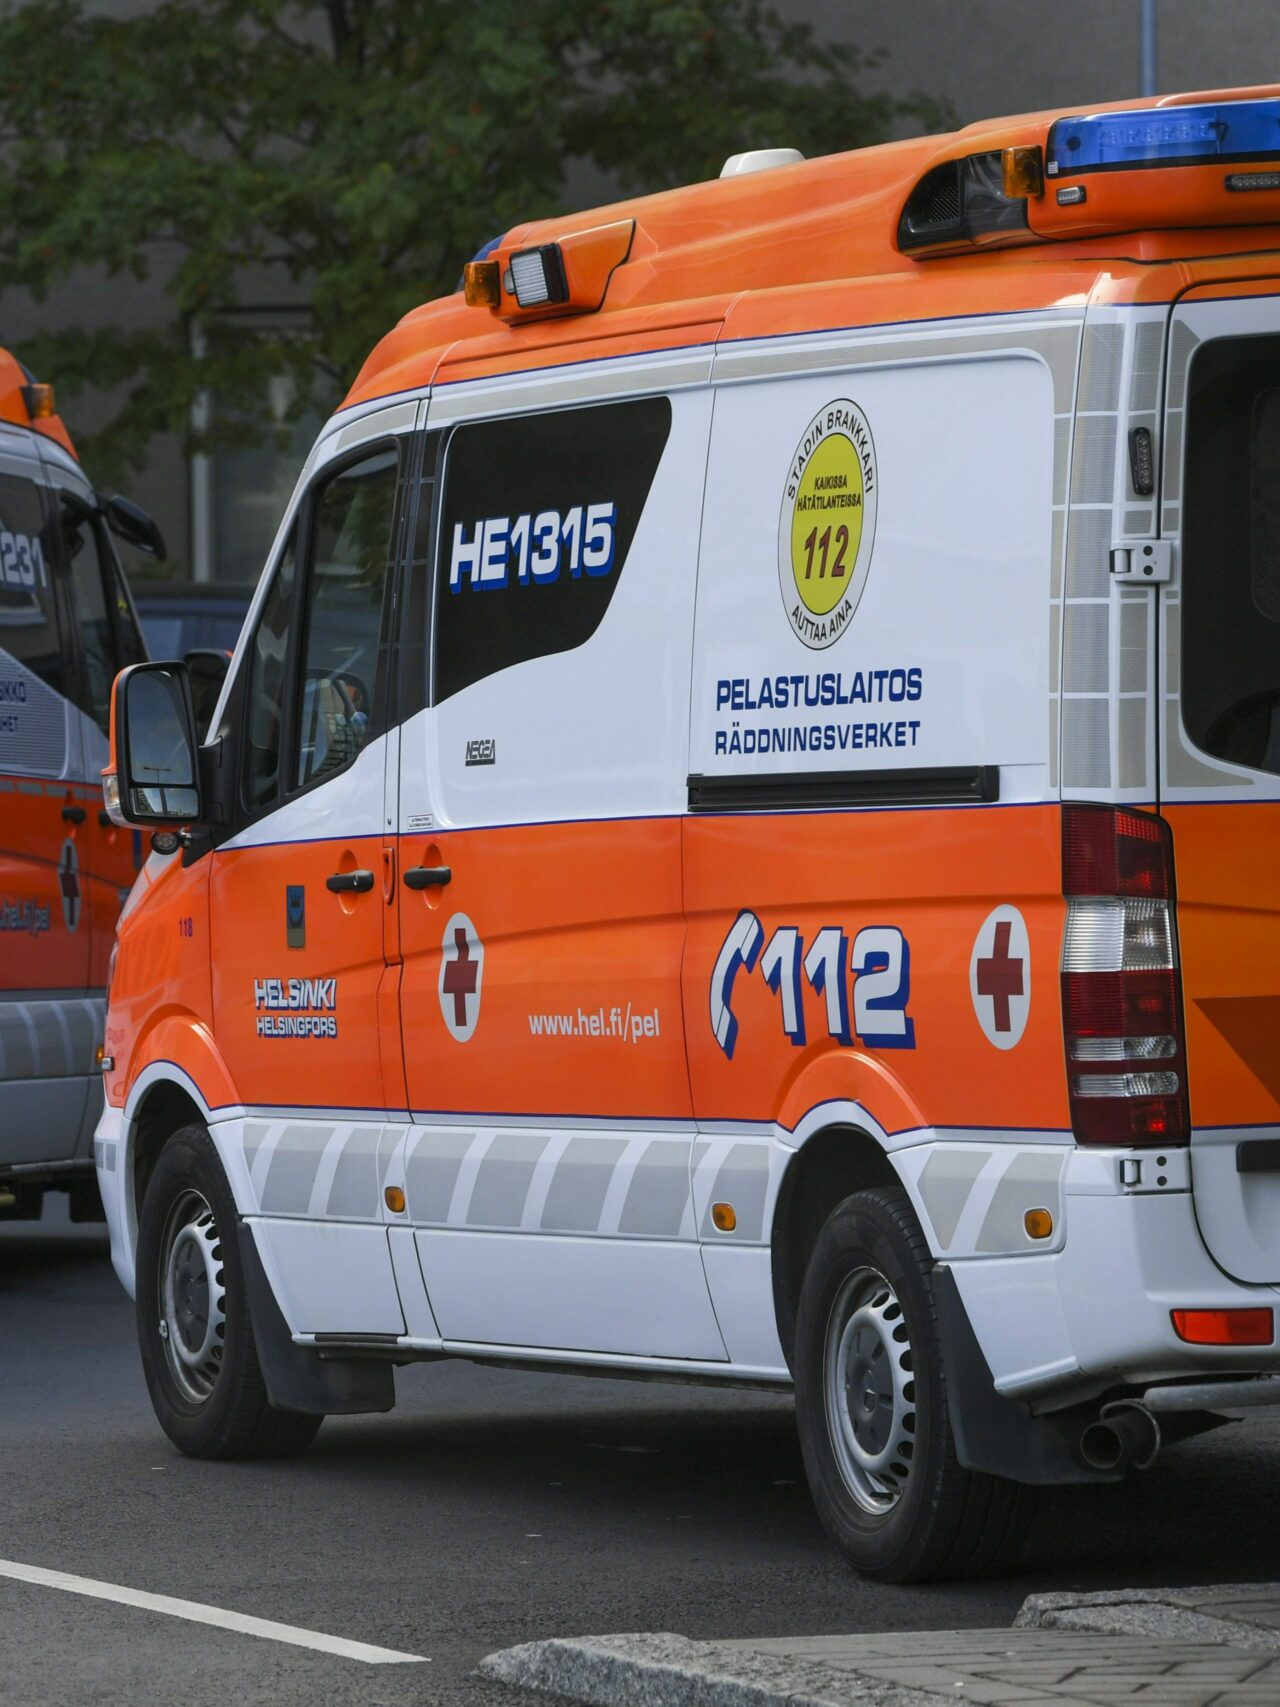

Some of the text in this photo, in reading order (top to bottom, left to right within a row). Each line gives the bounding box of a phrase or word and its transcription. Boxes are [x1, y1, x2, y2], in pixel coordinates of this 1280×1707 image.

[788, 410, 873, 499] STADIN BRANKKARI
[797, 493, 861, 511] HÄTÄTILANTEISSA
[814, 475, 848, 490] KAIKISSA
[450, 502, 617, 594] HE1315
[804, 524, 849, 579] 112
[791, 599, 852, 641] AUTTAA AINA
[716, 668, 922, 711] PELASTUSLAITOS
[715, 721, 920, 755] RÄDDNINGSVERKET
[179, 917, 193, 937] 118
[254, 978, 336, 1010] HELSINKI
[760, 925, 915, 1049] 112
[256, 1015, 337, 1038] HELSINGFORS
[528, 1002, 660, 1044] www.hel.fi/pel
